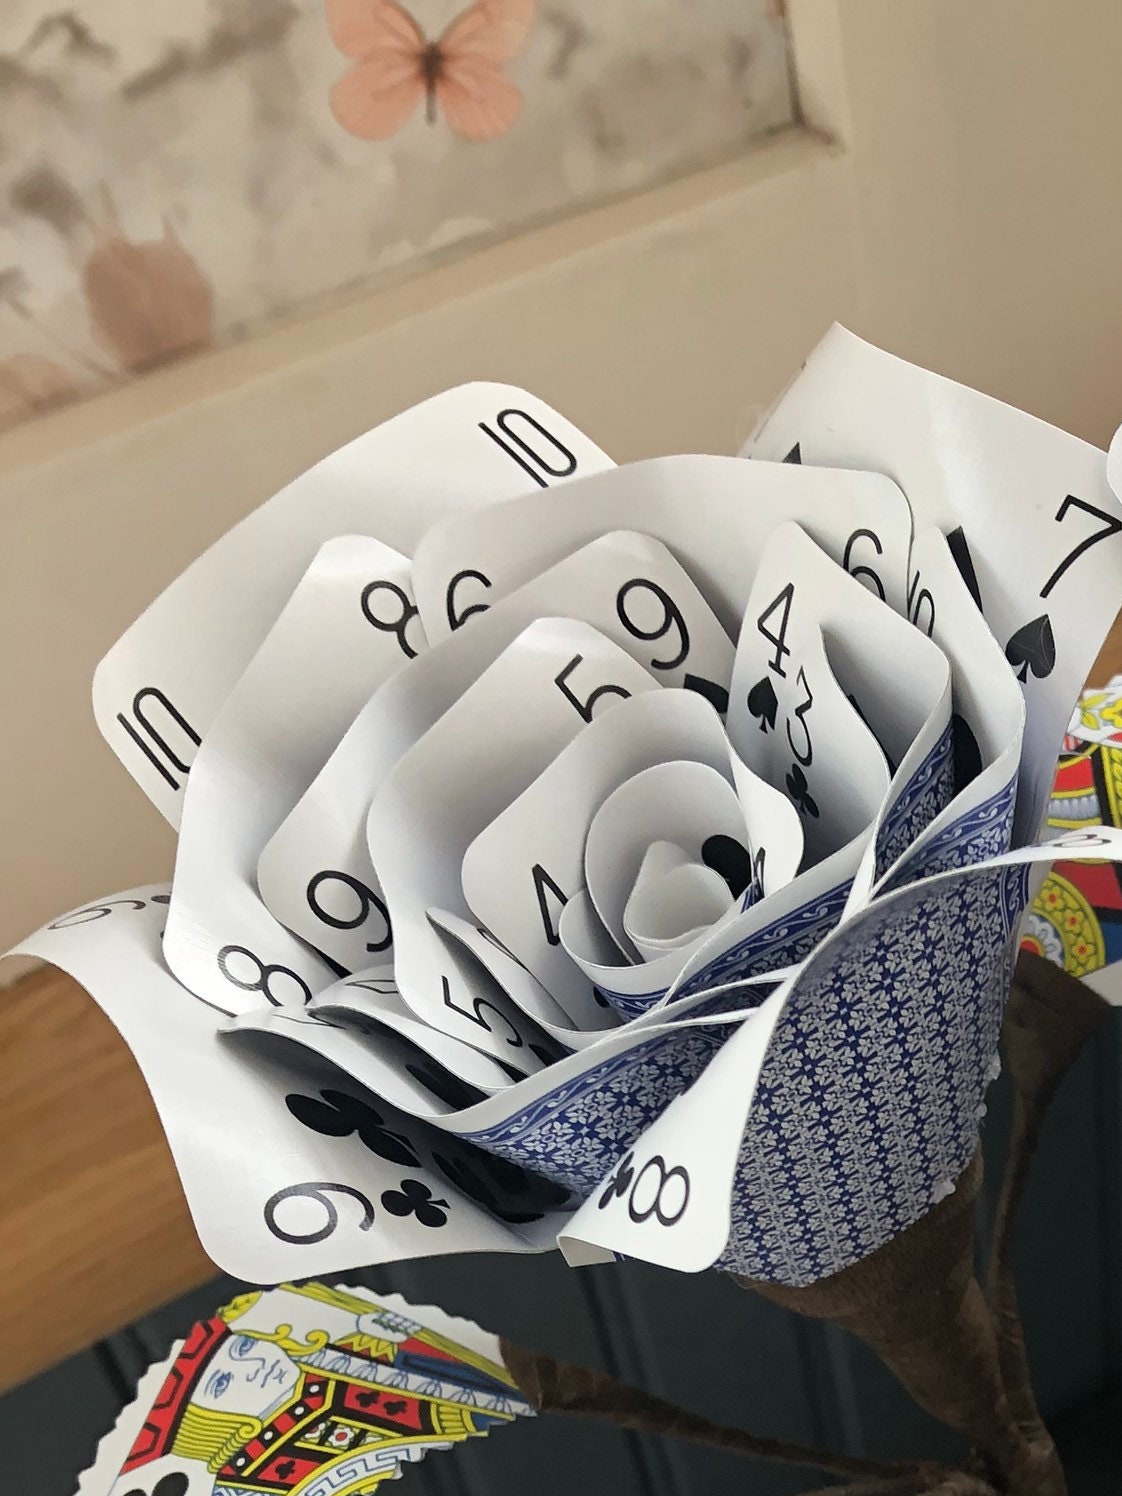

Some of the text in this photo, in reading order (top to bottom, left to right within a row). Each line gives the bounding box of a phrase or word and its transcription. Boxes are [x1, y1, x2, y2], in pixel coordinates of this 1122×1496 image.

[479, 409, 577, 488] 10
[1040, 495, 1122, 600] 7
[616, 578, 691, 670] 9
[757, 582, 795, 679] 4
[116, 687, 202, 791] 10
[306, 870, 394, 953] 9
[441, 975, 523, 1047] 5
[629, 1154, 690, 1227] 8
